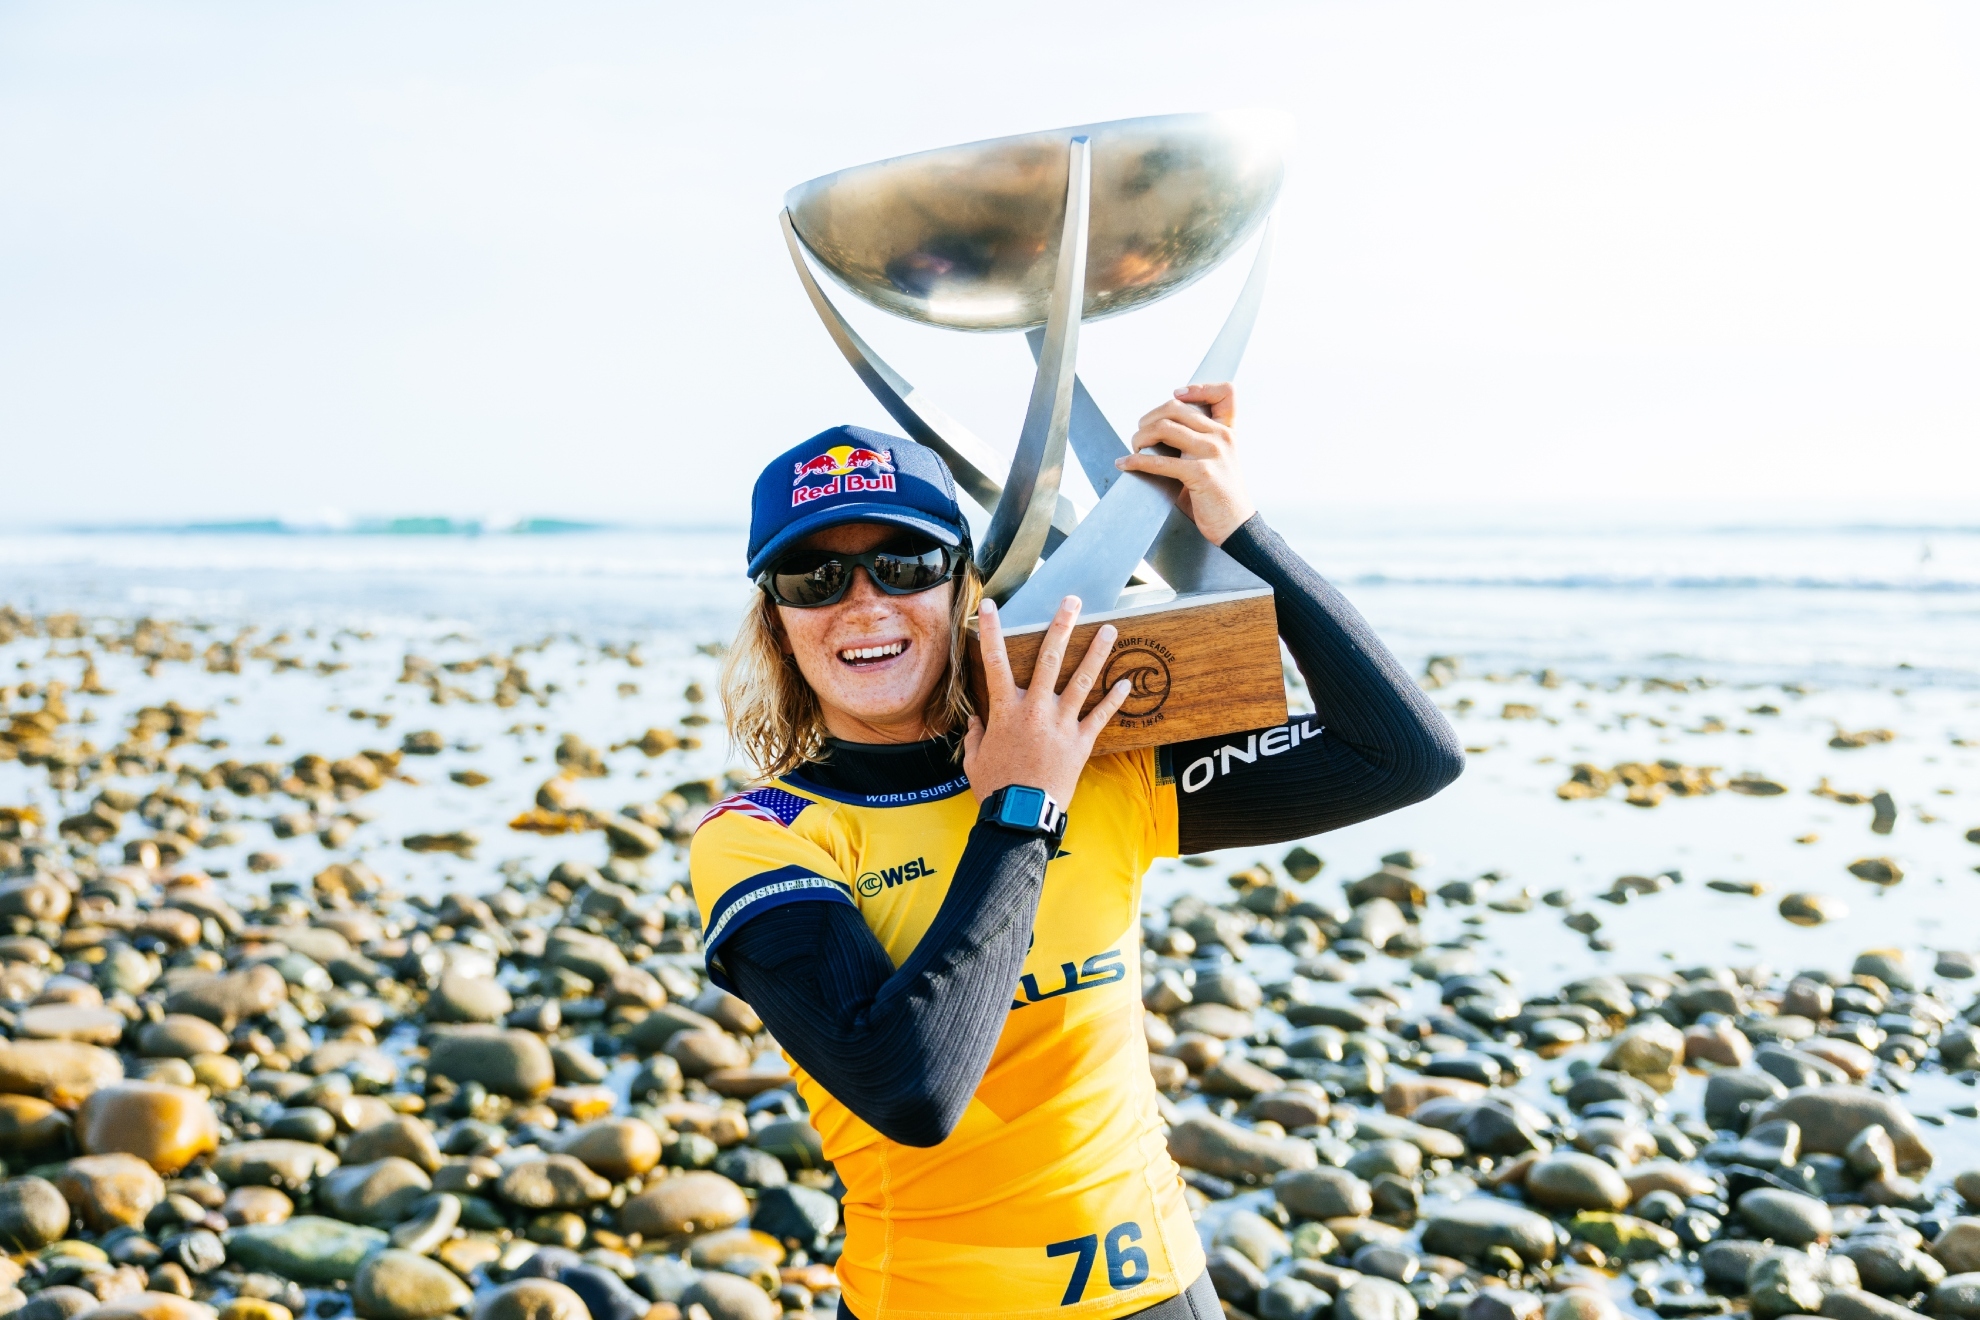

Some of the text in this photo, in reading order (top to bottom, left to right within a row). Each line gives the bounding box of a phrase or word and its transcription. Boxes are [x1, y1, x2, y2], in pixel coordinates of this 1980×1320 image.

[792, 474, 896, 507] Red Bull
[1117, 637, 1176, 663] SURF LEAGUE
[1182, 720, 1326, 794] O'NEIL
[866, 775, 969, 803] WORLD SURF LE
[880, 856, 936, 889] WSL
[1010, 948, 1126, 1011] US
[1046, 1221, 1150, 1306] 76
